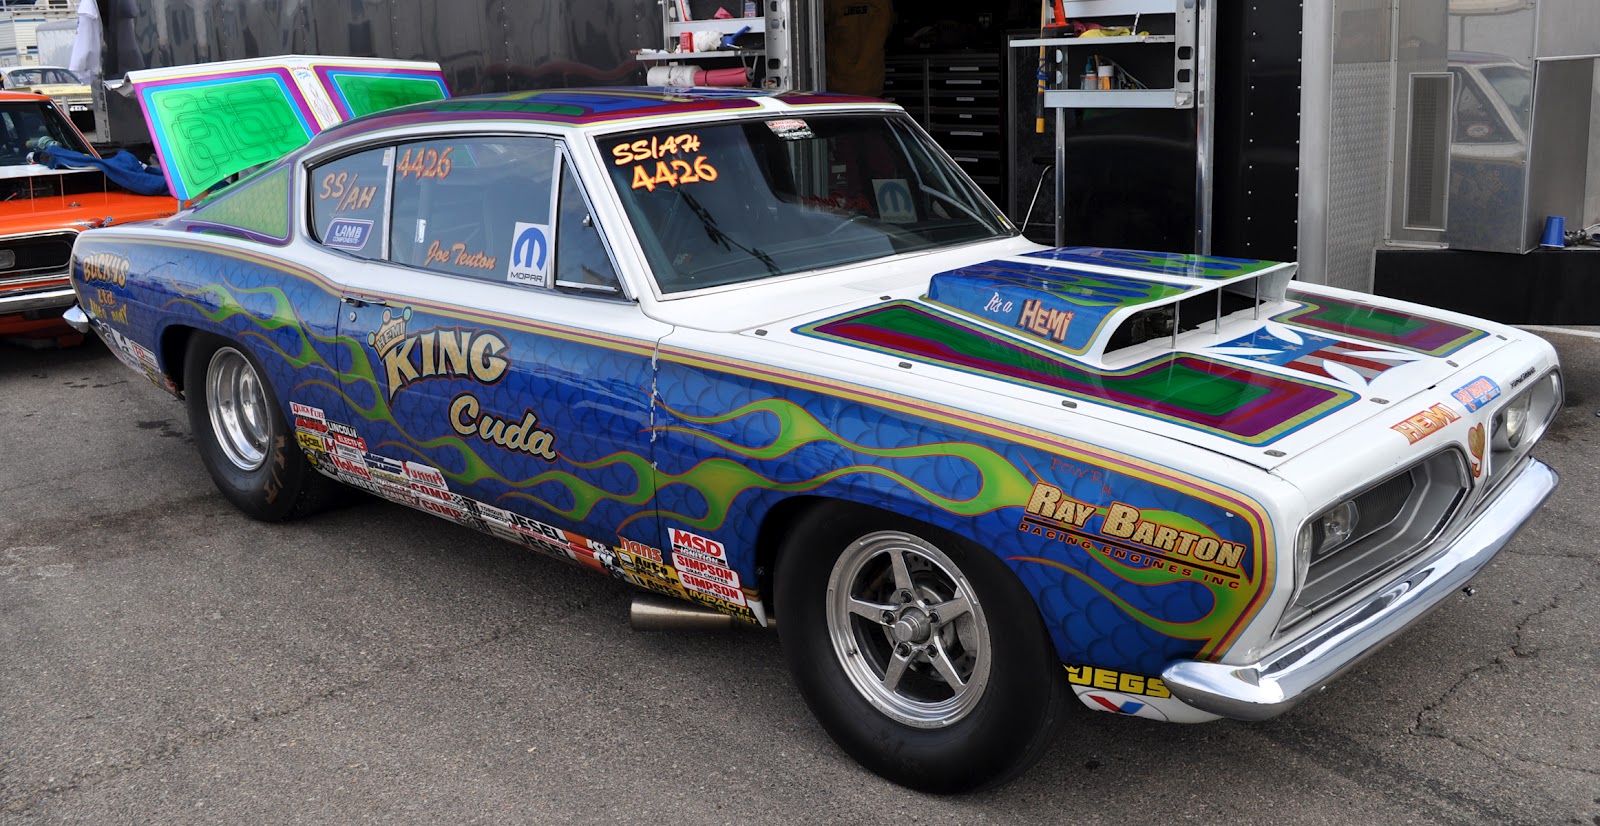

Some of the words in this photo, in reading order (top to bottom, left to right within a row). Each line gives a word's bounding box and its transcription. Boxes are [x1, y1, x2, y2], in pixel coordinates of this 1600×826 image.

[397, 146, 454, 180] 4426
[631, 156, 718, 192] 4426
[320, 172, 378, 212] SS/AH
[335, 225, 363, 238] LAMB
[425, 240, 451, 267] Joe
[452, 242, 497, 270] Teuton
[510, 271, 543, 283] MOPAR
[376, 321, 406, 351] HEMI
[384, 327, 510, 403] KING
[327, 421, 358, 438] LINCOLN
[449, 394, 557, 461] Cuda
[410, 483, 452, 501] COMP
[1025, 481, 1097, 529] RAY
[1101, 500, 1246, 569] BARTON
[673, 529, 722, 557] MSD
[1018, 523, 1092, 550] RACING
[1101, 545, 1192, 578] ENGINES
[1203, 573, 1241, 590] INC
[677, 555, 734, 581] SIMPSON
[683, 574, 739, 600] SIMPSON
[688, 589, 750, 616] IMPACT!
[1068, 666, 1172, 699] JEGS
